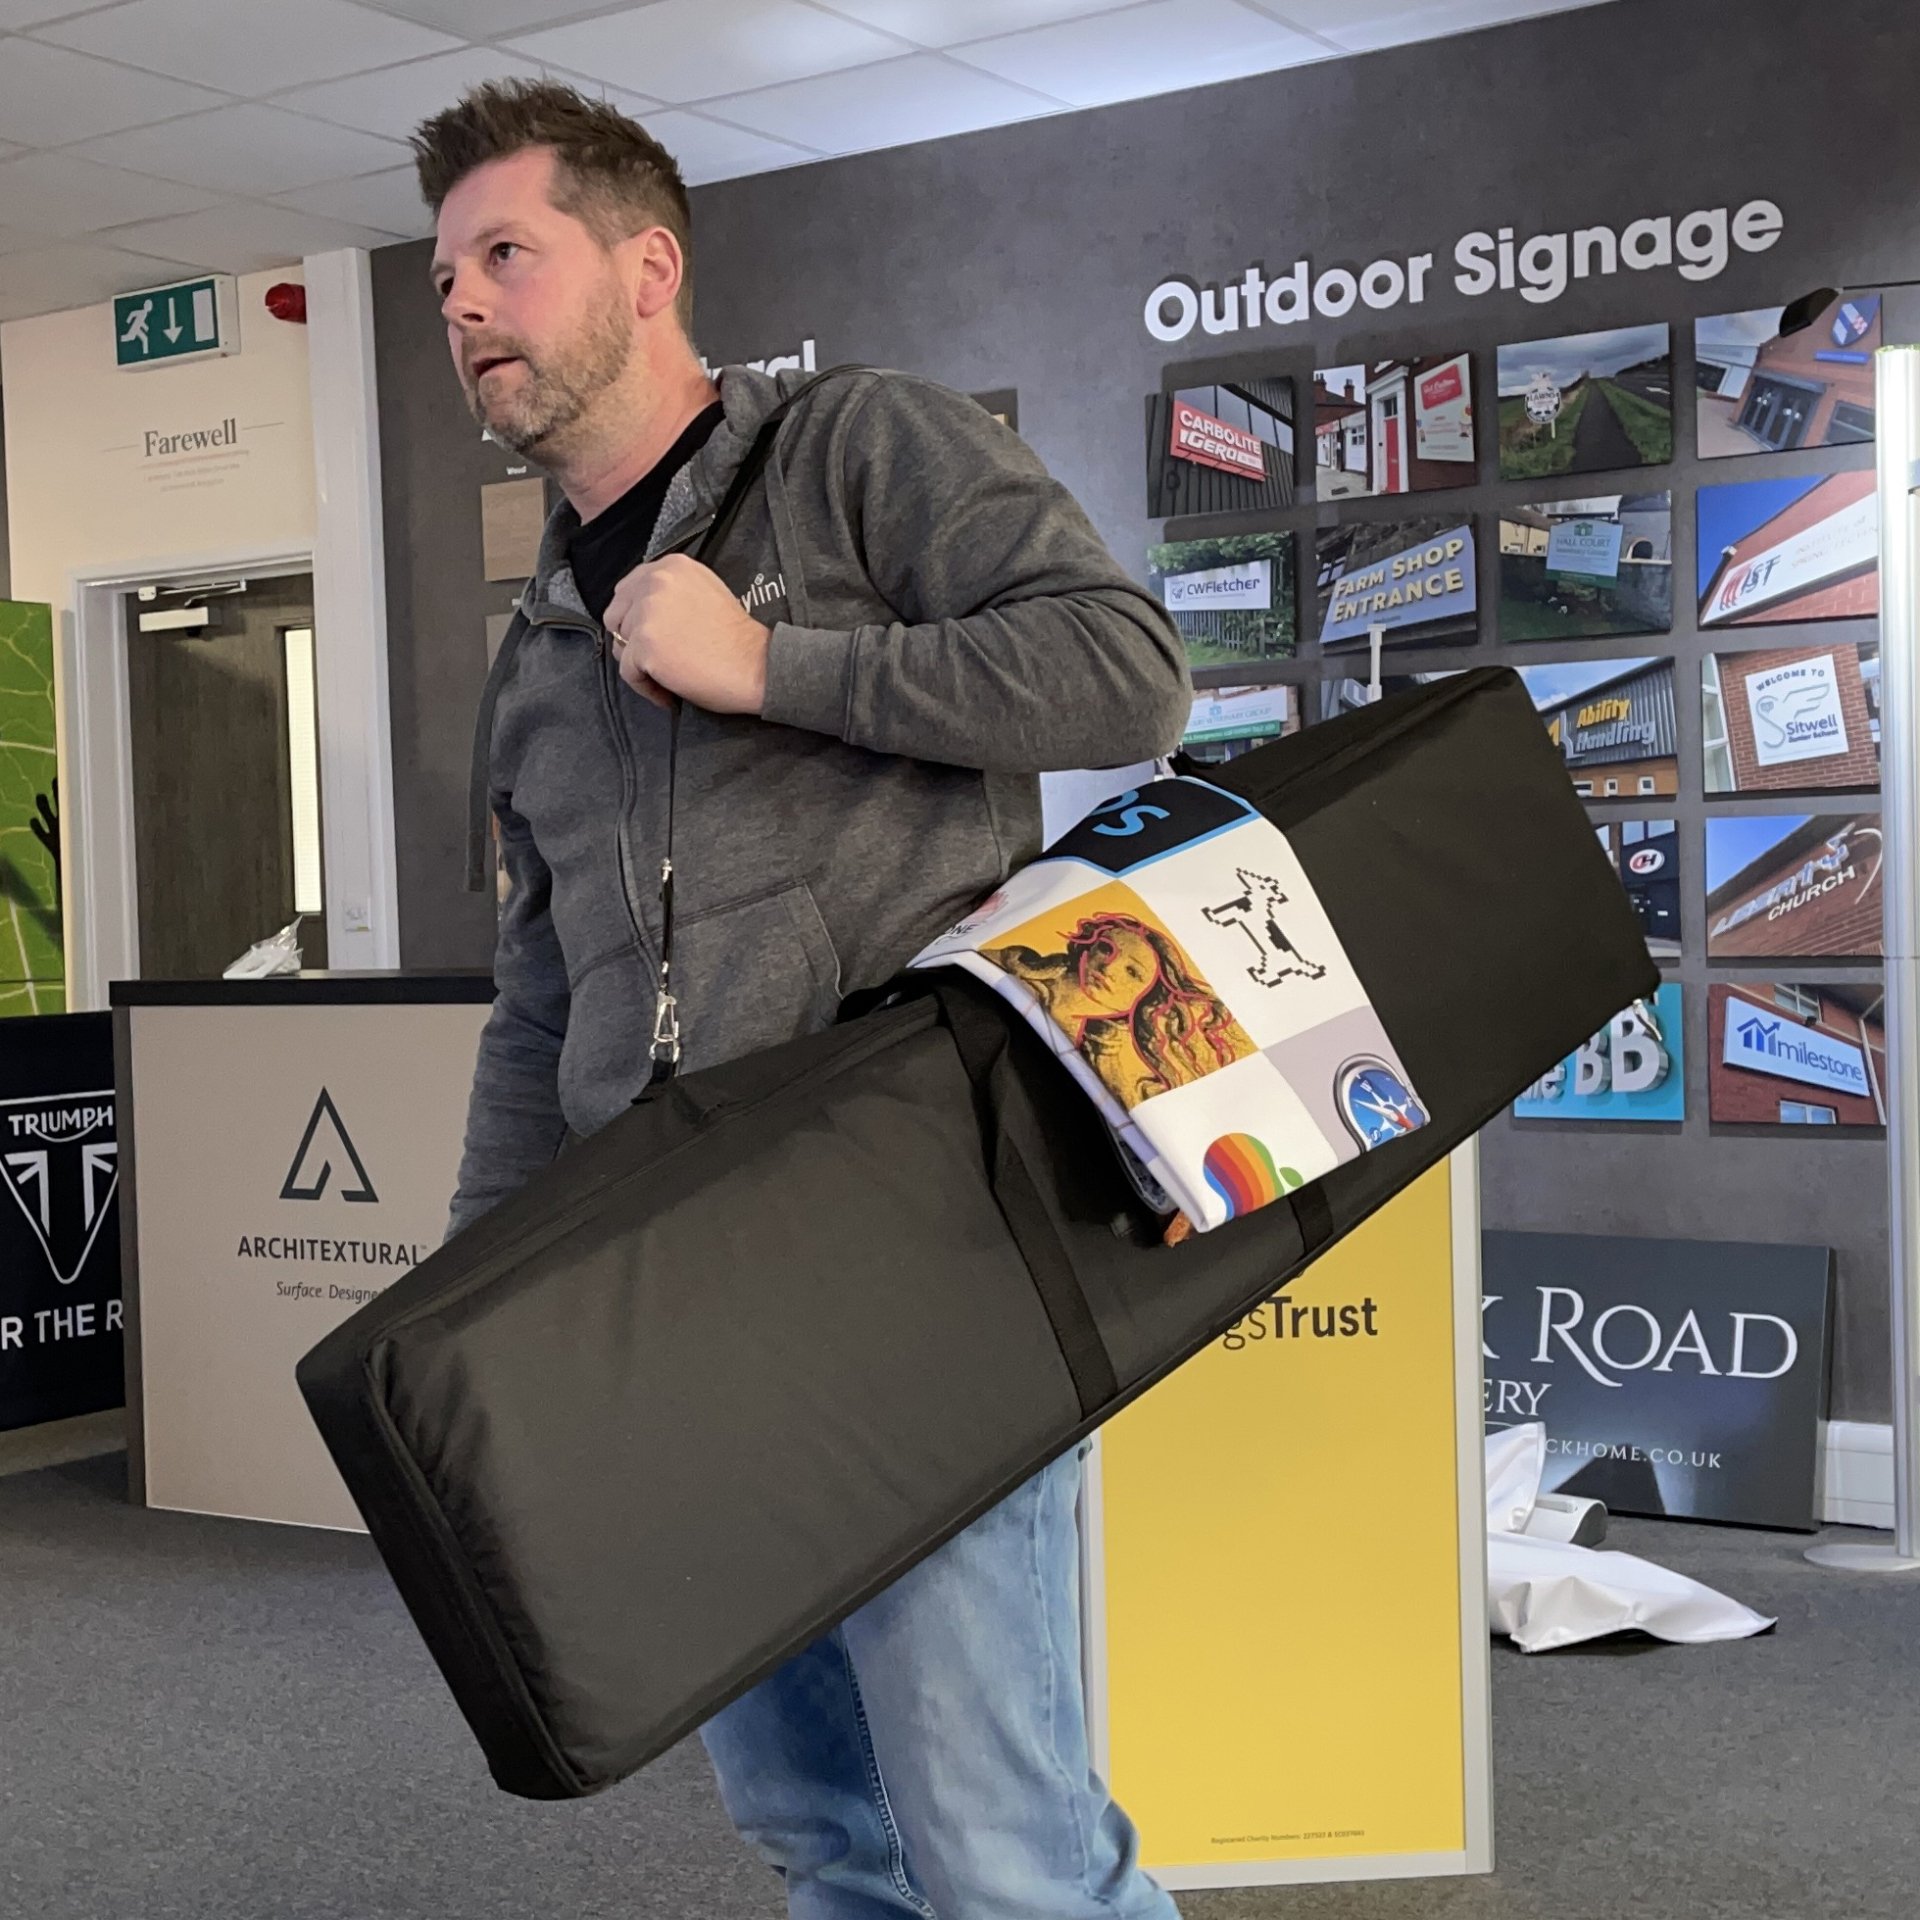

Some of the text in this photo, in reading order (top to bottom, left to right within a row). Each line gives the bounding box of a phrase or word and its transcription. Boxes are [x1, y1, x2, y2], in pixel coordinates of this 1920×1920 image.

[1144, 199, 1783, 342] Outdoor Signage
[143, 417, 238, 457] Farewell
[1180, 410, 1261, 455] CARBOLITE
[1335, 538, 1464, 599] FARM SHOP
[1332, 567, 1464, 624] ENTRANCE
[1756, 668, 1825, 692] WELCOME TO
[1576, 699, 1630, 728] Ability
[1786, 713, 1838, 736] Sitwell
[1575, 721, 1655, 752] Handling
[1768, 865, 1856, 921] CHURCH
[1777, 1040, 1863, 1081] milestone
[8, 1104, 114, 1143] TRIUMPH
[237, 1235, 422, 1266] ARCHITEXTURAL
[328, 1284, 388, 1305] Designe
[34, 1303, 96, 1343] THE
[1531, 1286, 1798, 1388] ROAD
